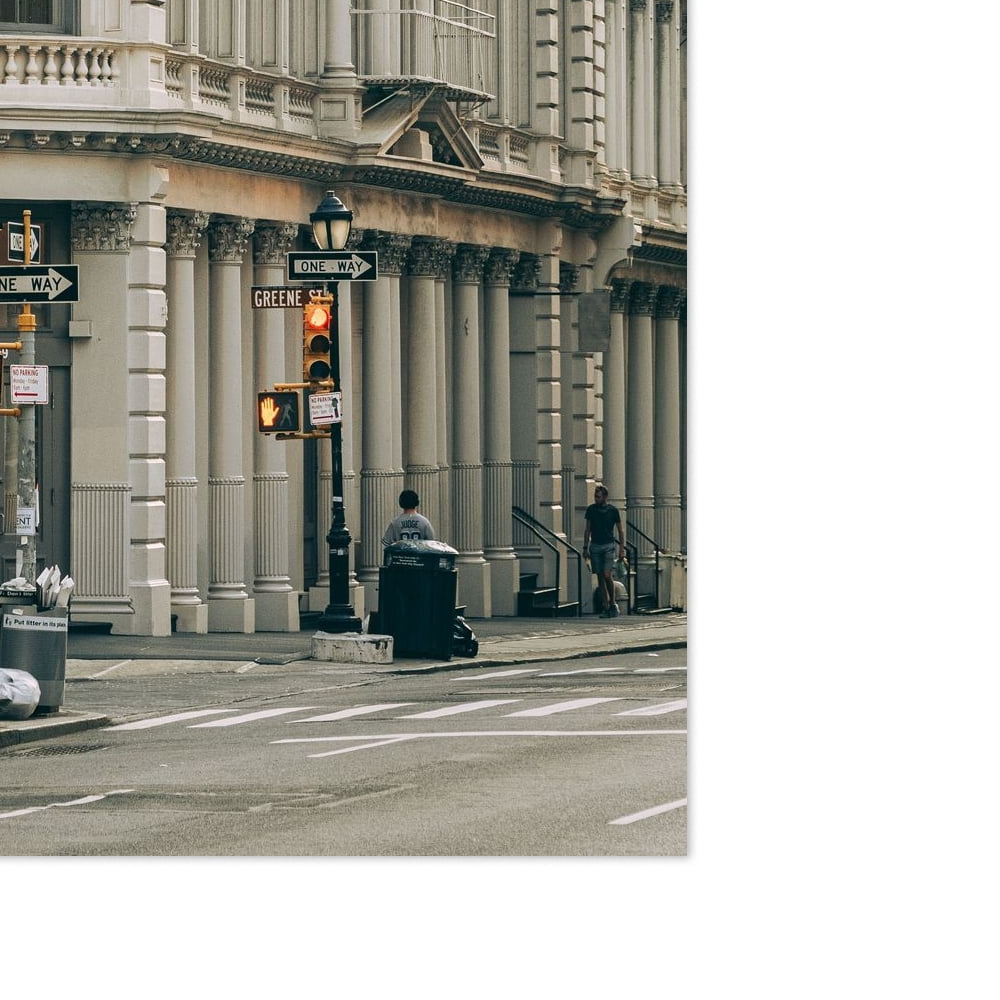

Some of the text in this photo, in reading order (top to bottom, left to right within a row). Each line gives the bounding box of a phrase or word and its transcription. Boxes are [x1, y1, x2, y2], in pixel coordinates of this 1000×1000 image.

[301, 260, 363, 272] ONE WAY
[31, 277, 62, 292] WAY
[254, 289, 303, 307] GREENE
